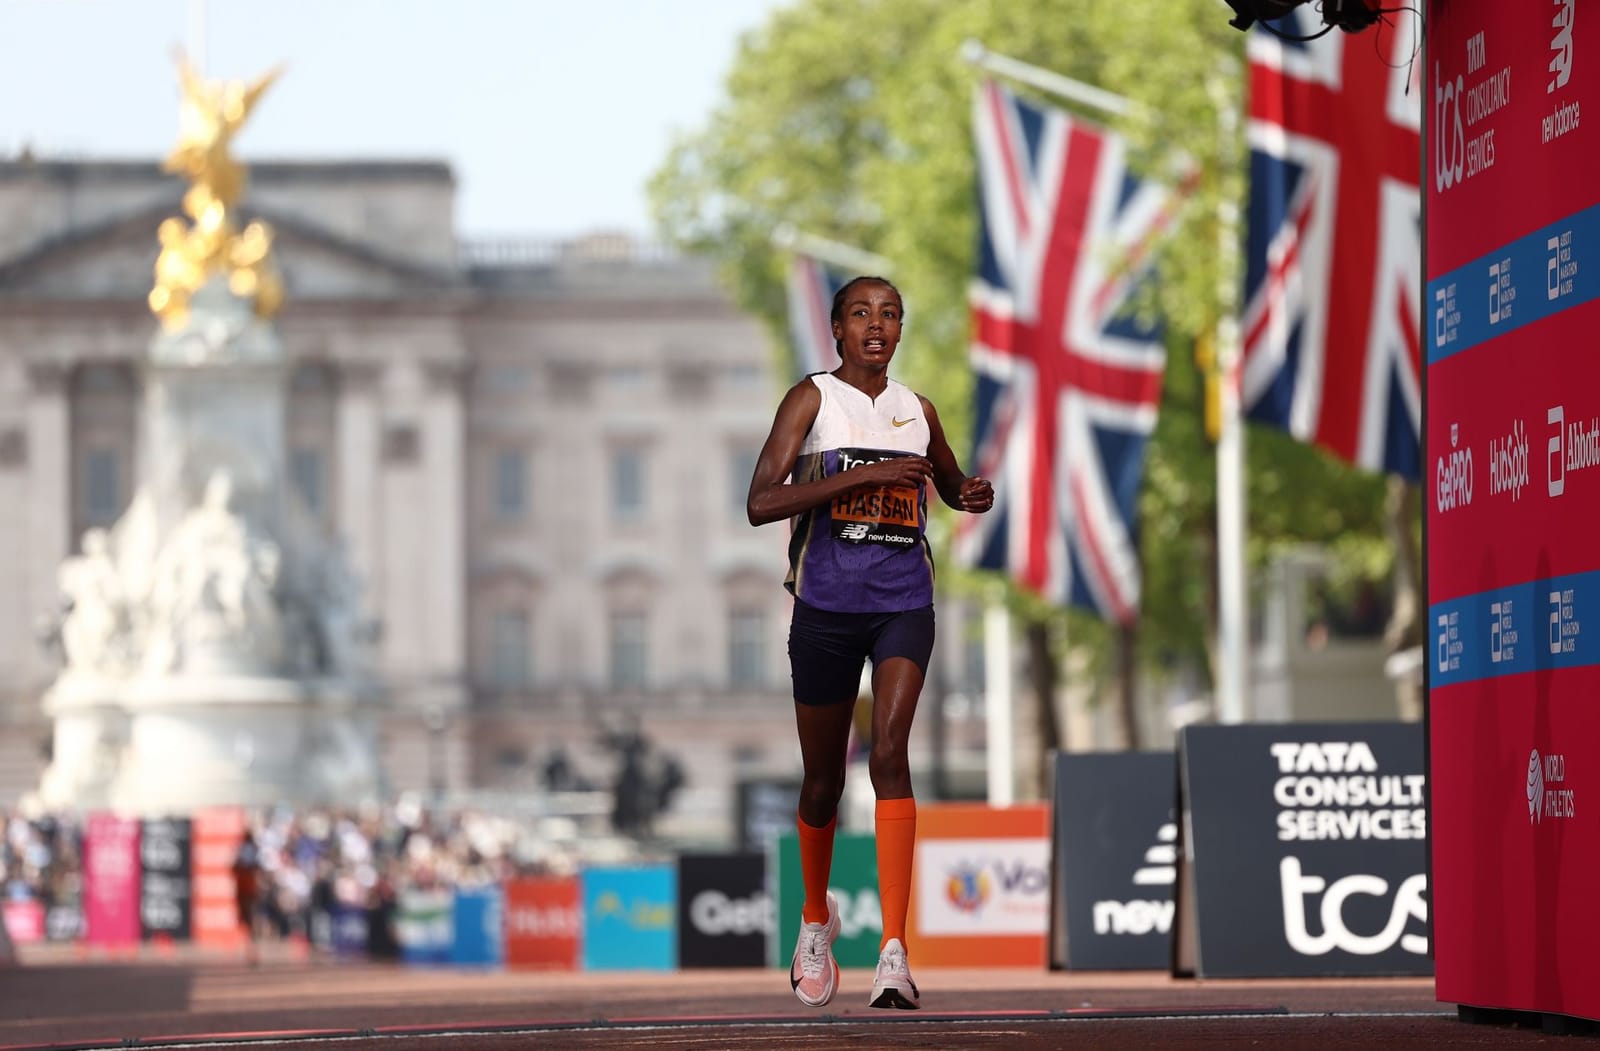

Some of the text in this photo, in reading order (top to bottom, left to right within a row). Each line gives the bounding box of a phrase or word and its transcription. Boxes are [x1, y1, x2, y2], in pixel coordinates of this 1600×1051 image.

[1466, 30, 1486, 74] TATA
[1466, 65, 1511, 126] CONSULTANCY
[1435, 59, 1464, 193] tcs
[1542, 100, 1580, 145] new balance
[1466, 129, 1495, 178] SERVICES
[1489, 418, 1529, 502] HubSpot
[1566, 417, 1600, 471] Abbott
[1437, 447, 1473, 513] GetPRO
[837, 492, 914, 521] HASSAN
[885, 533, 914, 544] balance
[1271, 742, 1377, 772] TATA
[1545, 754, 1565, 782] WORLD
[1274, 775, 1425, 806] CONSULT
[1545, 789, 1575, 818] ATHLETICS
[1276, 810, 1426, 840] SERVICES
